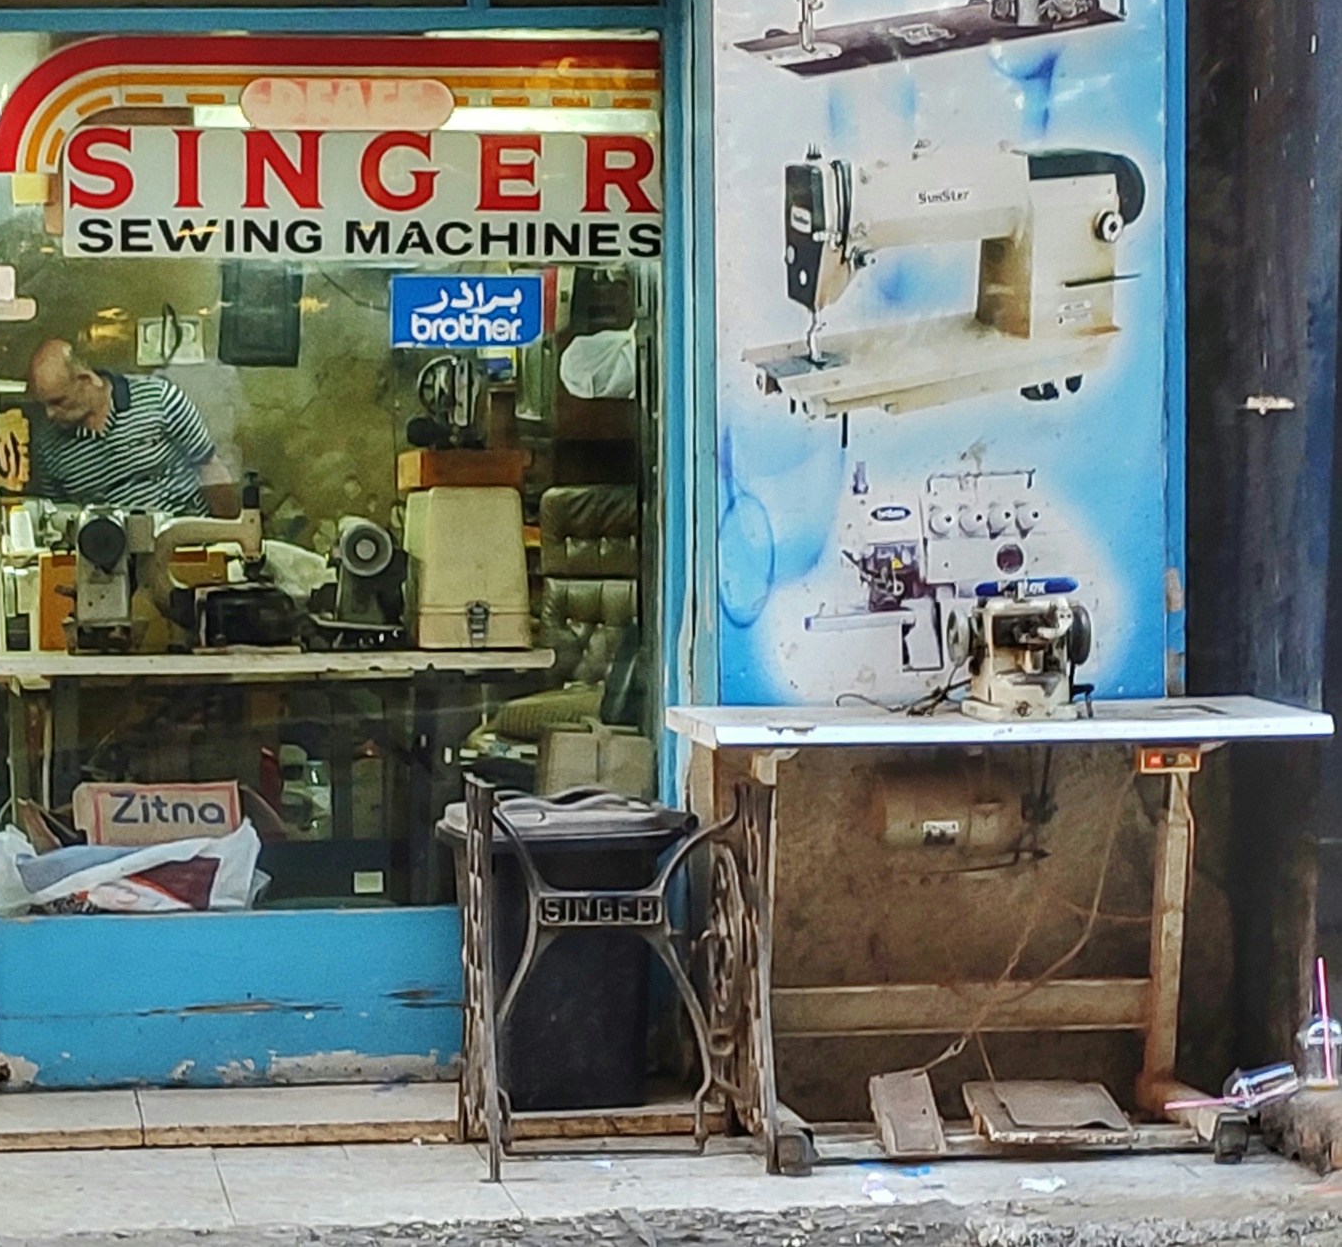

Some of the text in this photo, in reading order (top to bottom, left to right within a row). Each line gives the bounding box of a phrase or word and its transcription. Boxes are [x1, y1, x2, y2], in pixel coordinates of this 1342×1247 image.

[68, 128, 661, 213] SINGER
[77, 217, 663, 258] SEWING MACHINES
[410, 312, 522, 342] brother
[109, 788, 226, 825] Zitna
[544, 897, 658, 923] SINGER
